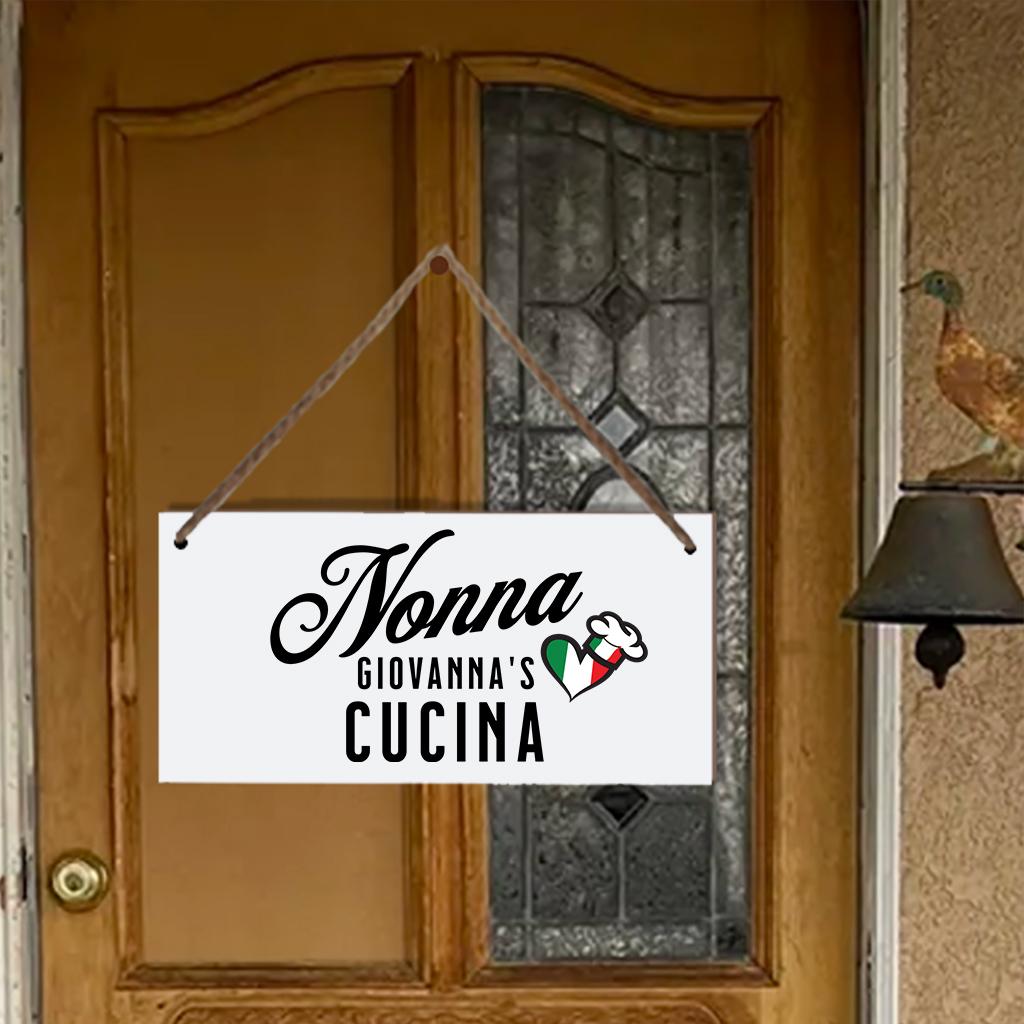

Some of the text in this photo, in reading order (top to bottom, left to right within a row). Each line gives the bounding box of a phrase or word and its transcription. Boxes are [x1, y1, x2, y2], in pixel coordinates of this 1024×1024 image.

[270, 529, 583, 664] Nonna
[357, 656, 535, 690] GIOVANNA'S
[345, 700, 545, 763] CUCINA
